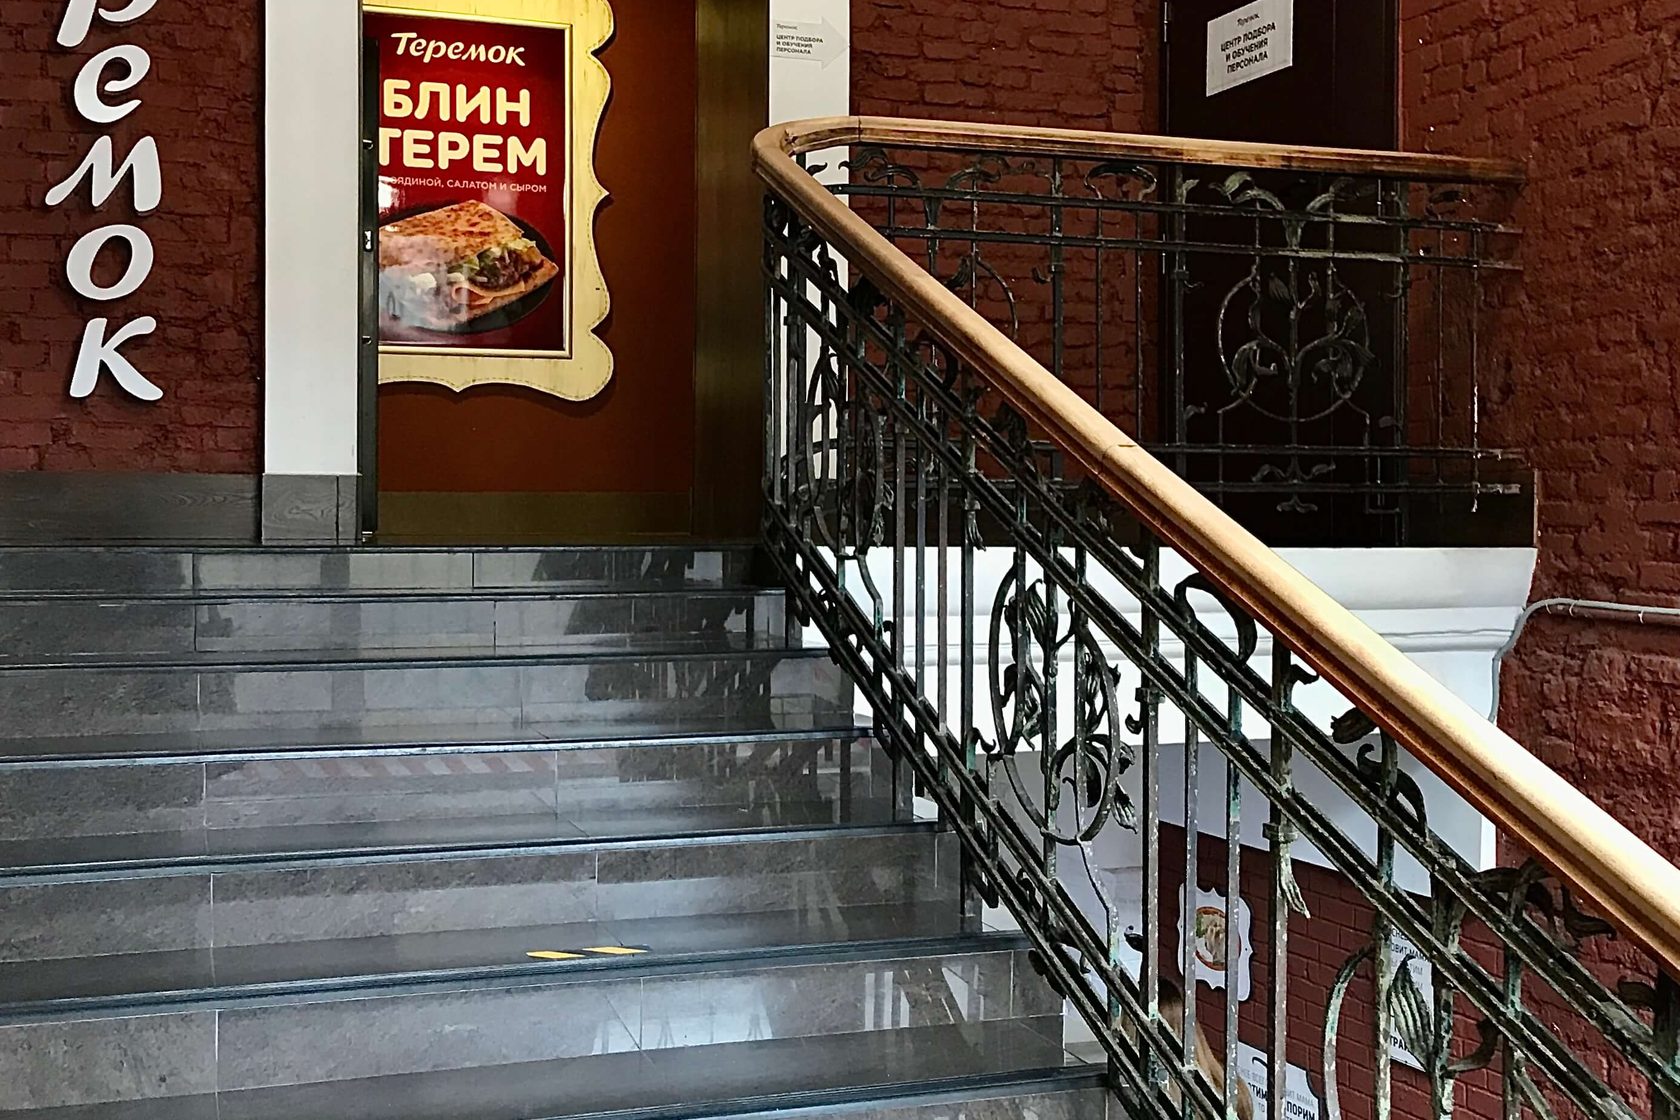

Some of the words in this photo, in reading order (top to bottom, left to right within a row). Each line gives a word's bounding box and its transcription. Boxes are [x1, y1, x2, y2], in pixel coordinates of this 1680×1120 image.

[391, 32, 526, 67] Теремок
[1220, 36, 1242, 52] ЦЕНТР
[1243, 22, 1276, 43] ПОДБОРА
[1225, 53, 1231, 62] И
[1232, 37, 1269, 60] ОБУЧЕНИЯ
[1227, 51, 1268, 74] ПЕРСОНАЛА
[383, 78, 531, 127] БЛИН
[446, 179, 497, 190] САЛАТОМ
[499, 181, 507, 190] И
[510, 183, 547, 193] СЫРОМ
